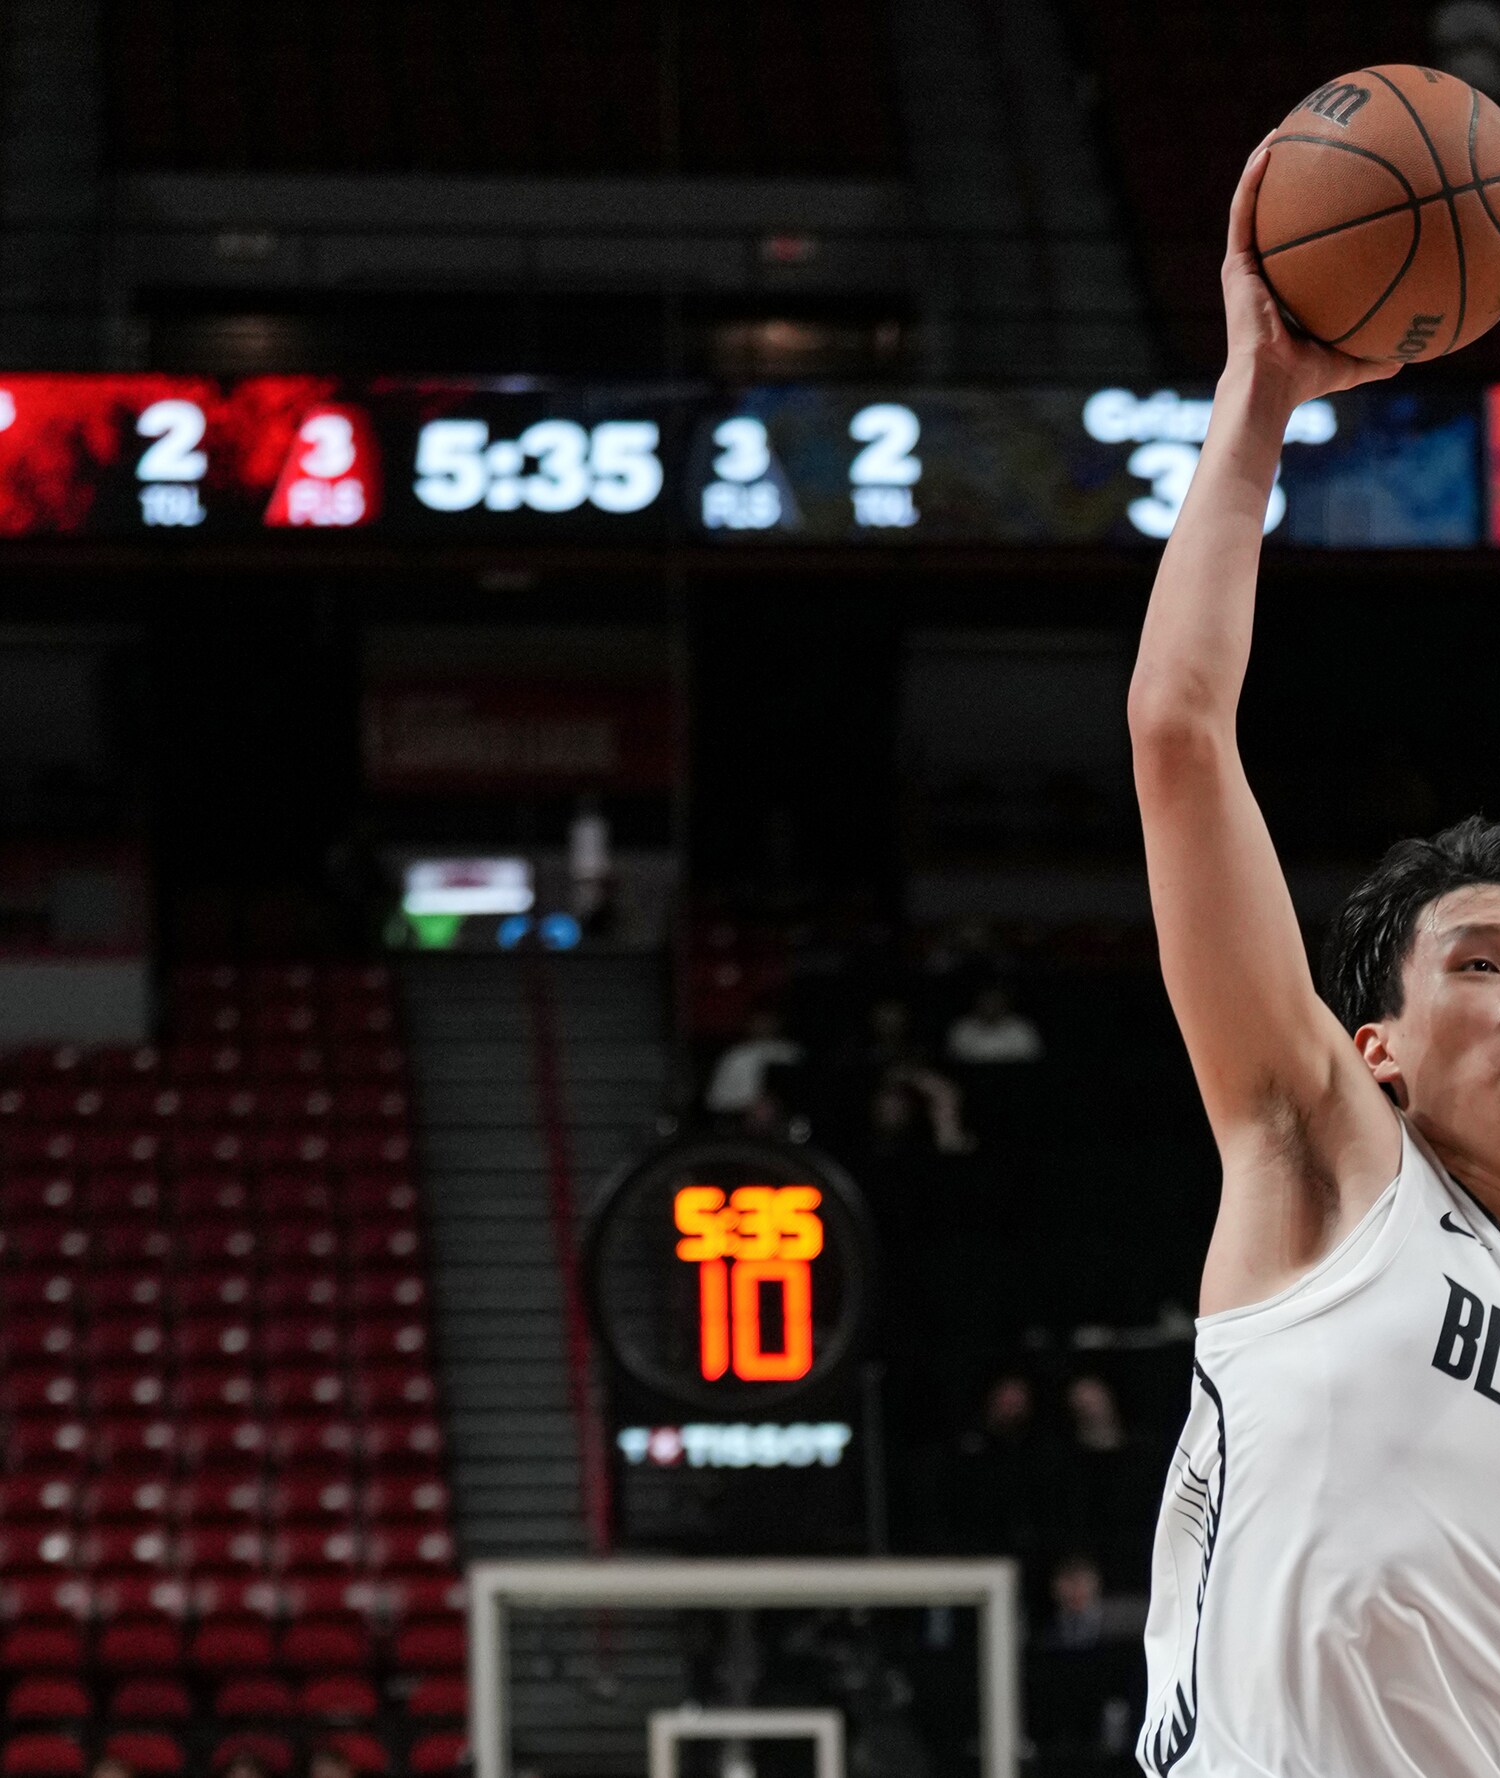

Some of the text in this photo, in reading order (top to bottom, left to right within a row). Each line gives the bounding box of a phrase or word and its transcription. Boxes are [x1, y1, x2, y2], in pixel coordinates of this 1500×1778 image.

[136, 398, 208, 481] 2
[300, 413, 355, 478] 3
[414, 420, 663, 513] 5:35
[713, 416, 770, 483] 3
[848, 402, 922, 487] 2
[674, 1186, 823, 1262] 5:35
[700, 1261, 813, 1381] 10
